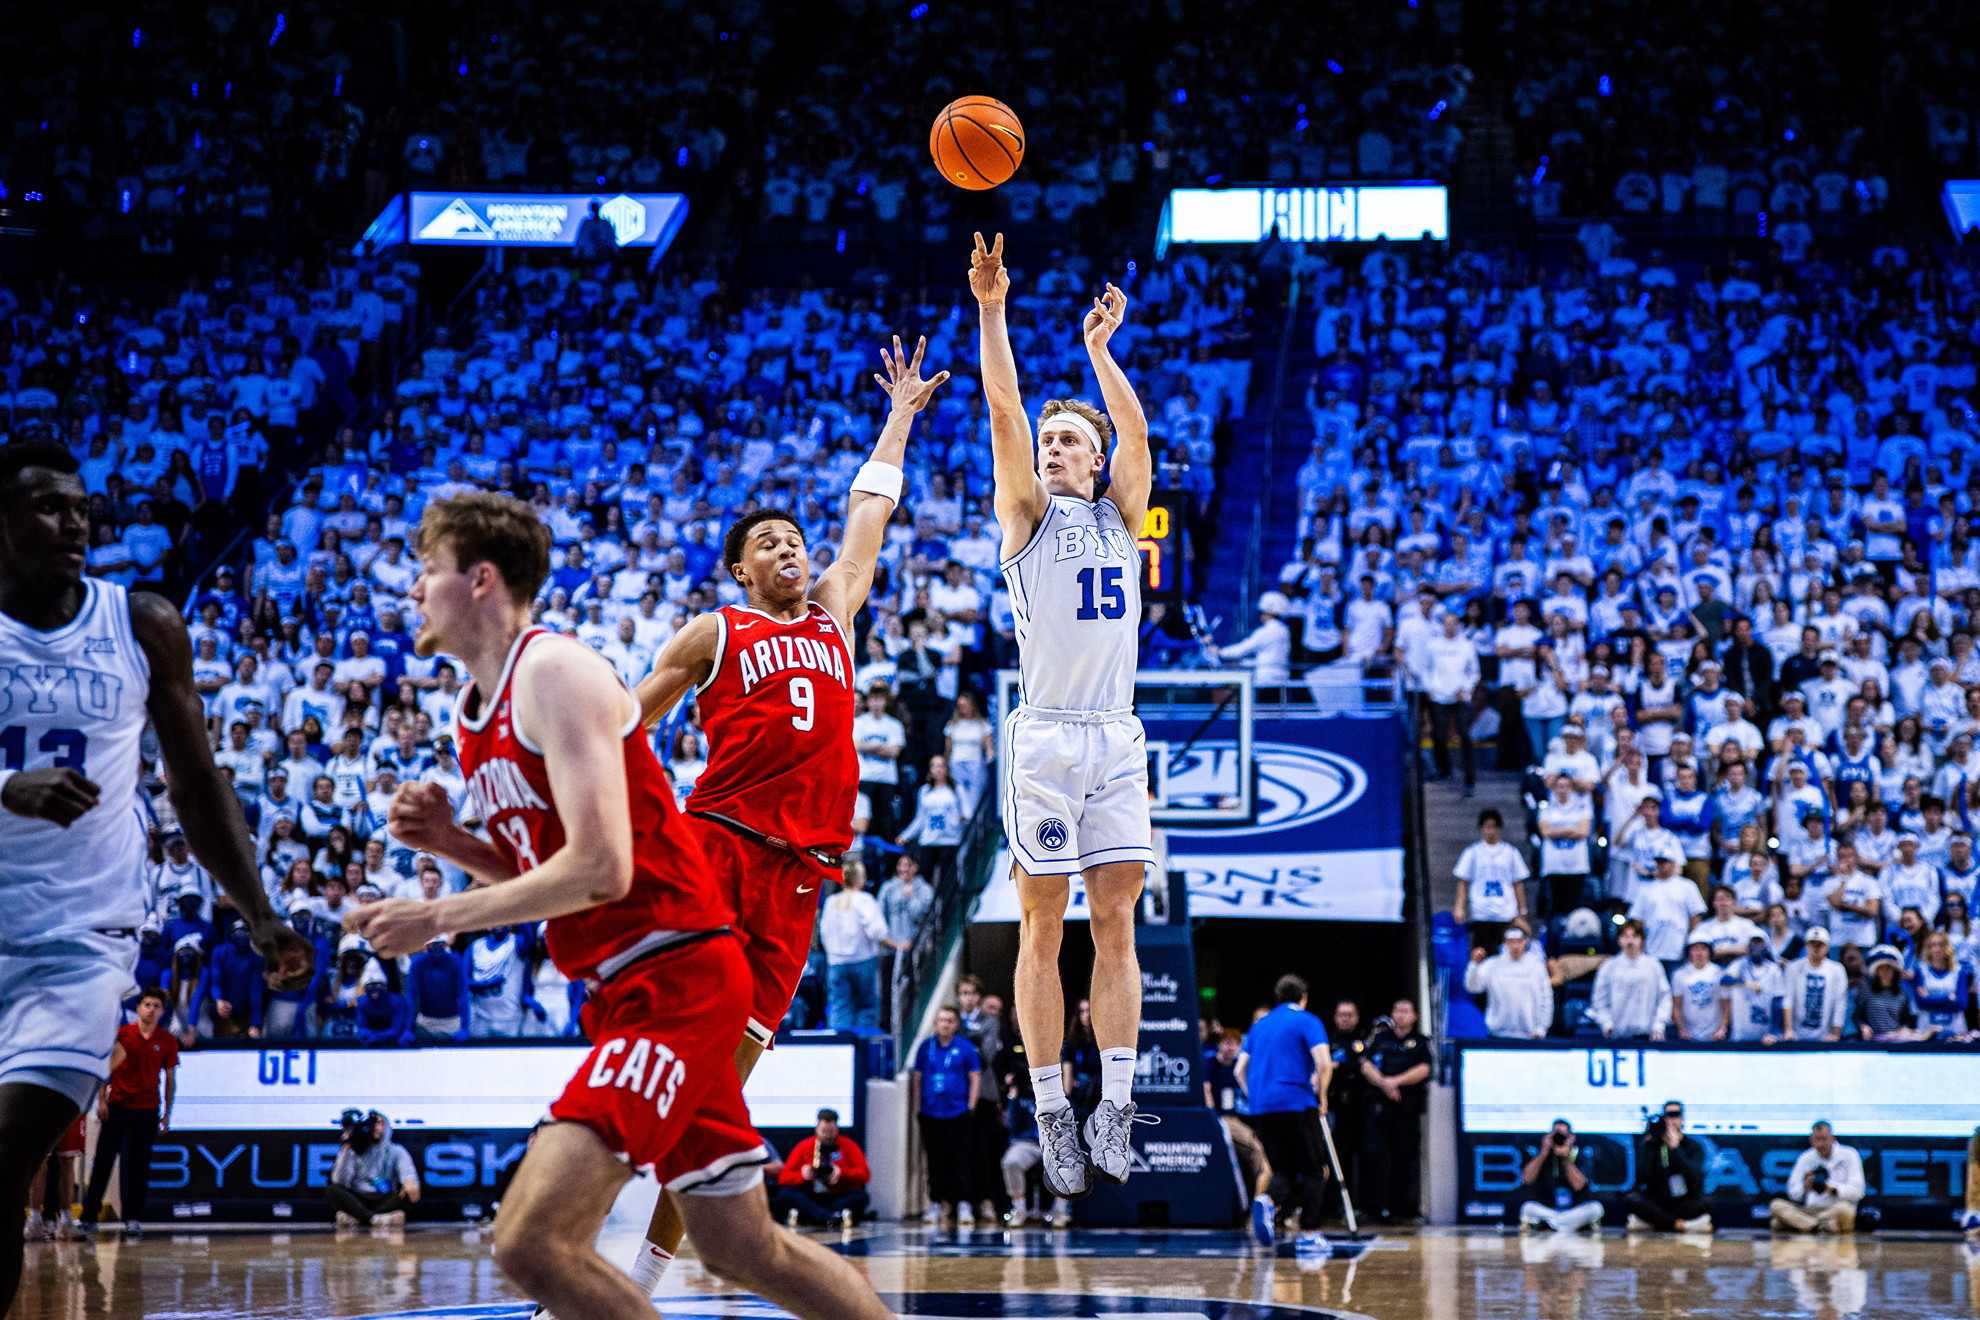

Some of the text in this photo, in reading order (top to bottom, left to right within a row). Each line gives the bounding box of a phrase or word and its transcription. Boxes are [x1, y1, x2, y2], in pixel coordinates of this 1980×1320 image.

[1055, 525, 1127, 562] BYU
[1077, 567, 1126, 620] 15
[739, 635, 847, 694] ARIZONA
[789, 676, 815, 732] 9
[258, 1049, 317, 1086] GET
[587, 1037, 686, 1120] CATS
[1587, 1049, 1646, 1088] GET
